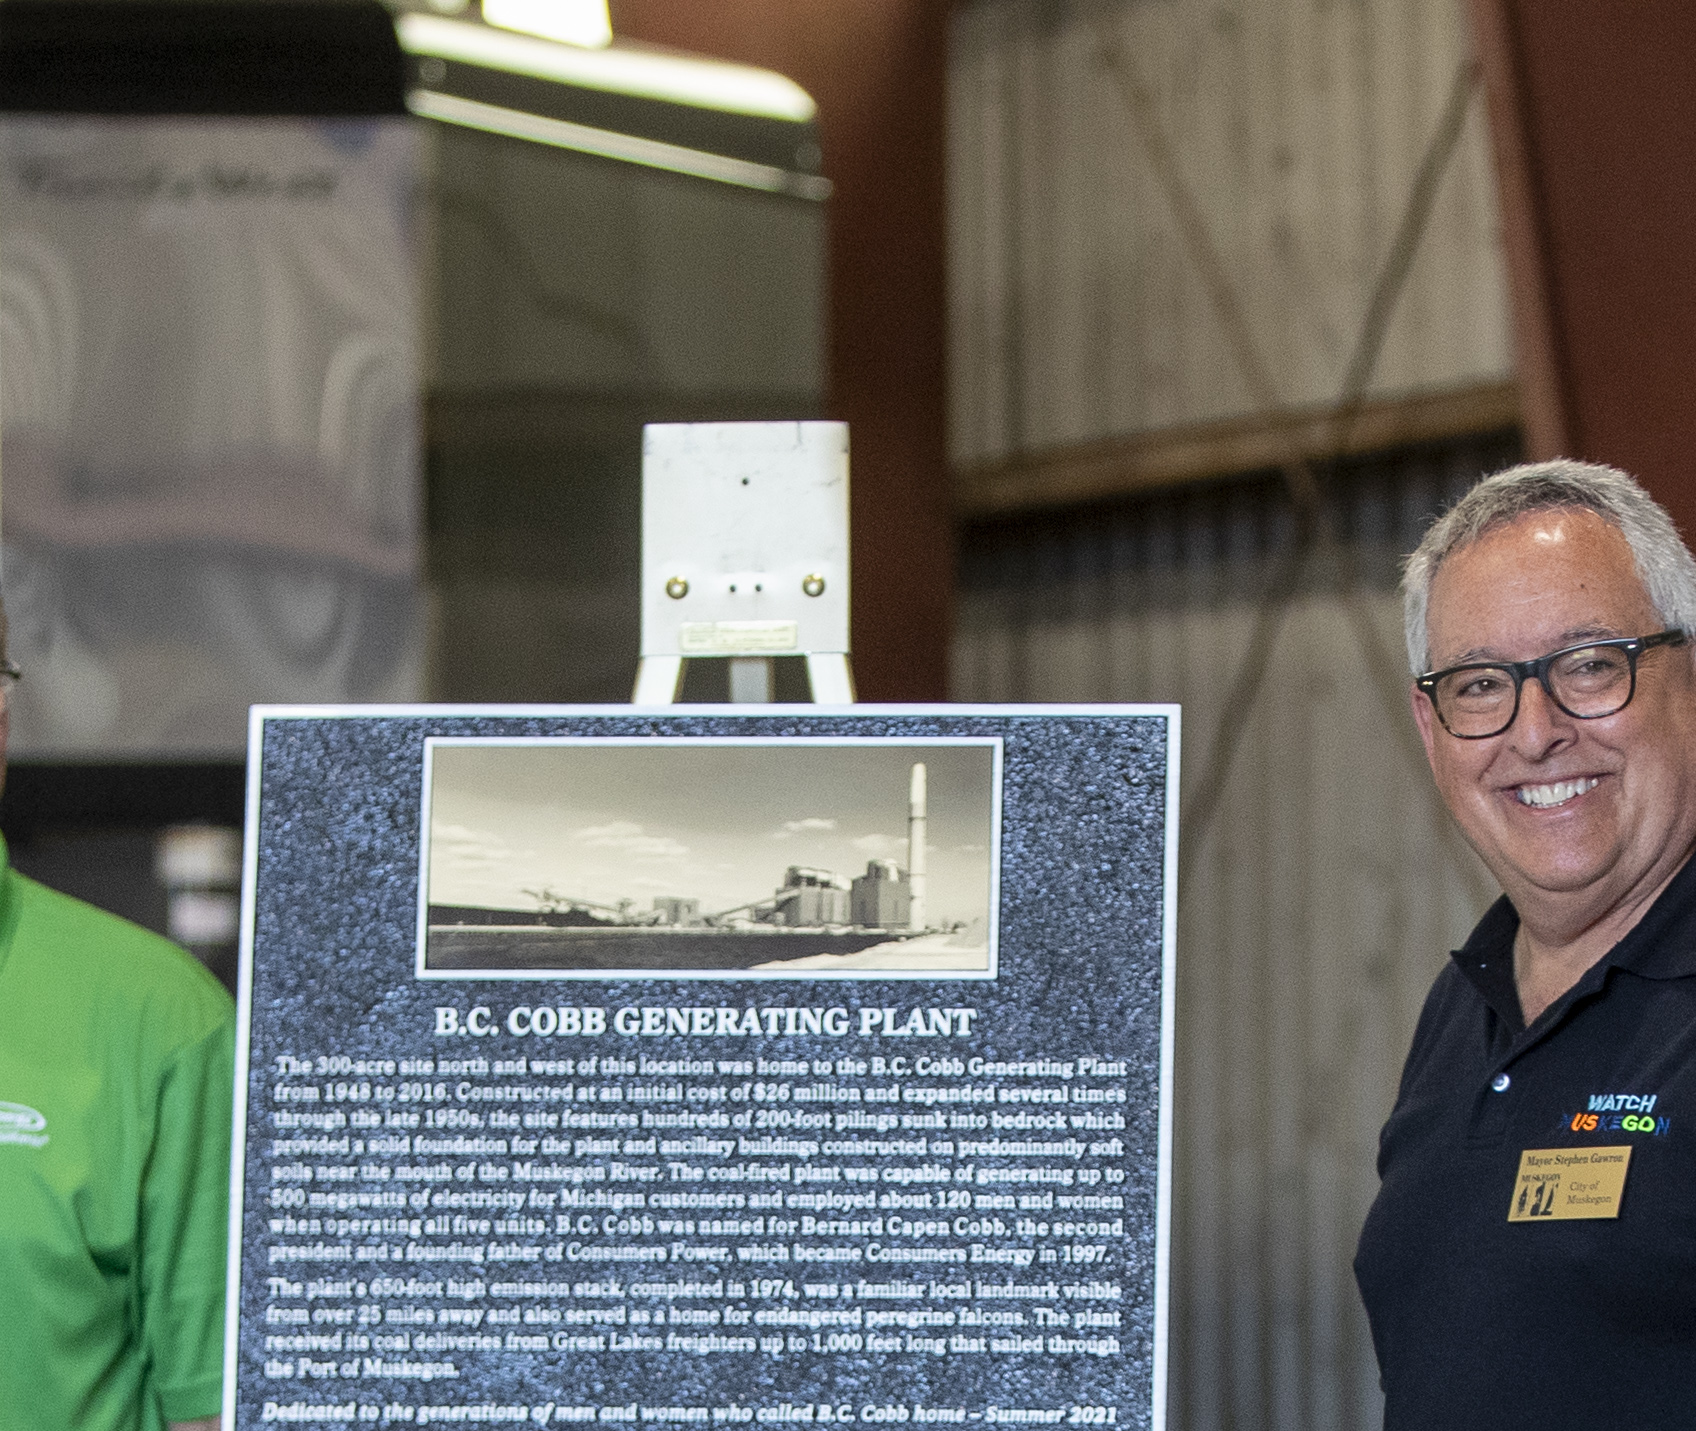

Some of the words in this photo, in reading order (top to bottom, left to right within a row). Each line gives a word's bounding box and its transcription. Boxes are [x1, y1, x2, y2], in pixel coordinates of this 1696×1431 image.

[434, 1008, 500, 1036] B.C.
[506, 1008, 606, 1036] COBB
[613, 1008, 850, 1037] GENERATING
[858, 1008, 977, 1037] PLANT
[274, 1056, 313, 1076] The
[316, 1057, 396, 1076] 300-acre
[398, 1057, 435, 1076] site
[438, 1057, 489, 1076] north
[530, 1058, 574, 1076] west
[601, 1057, 636, 1076] this
[639, 1057, 714, 1076] location
[756, 1057, 809, 1076] home
[870, 1057, 912, 1076] B.C.
[915, 1057, 965, 1076] Cobb
[968, 1057, 1074, 1079] Generating
[1077, 1057, 1127, 1076] Plant
[273, 1083, 320, 1102] from
[324, 1083, 372, 1102] 1948
[398, 1083, 452, 1102] 2016.
[456, 1084, 574, 1102] Constructed
[626, 1084, 683, 1102] initial
[686, 1086, 727, 1102] cost
[752, 1084, 790, 1102] $26
[793, 1085, 861, 1102] million
[903, 1085, 995, 1105] expanded
[998, 1085, 1069, 1103] several
[1072, 1085, 1127, 1103] times
[1587, 1093, 1658, 1113] WATCH
[273, 1110, 346, 1131] through
[384, 1110, 420, 1129] late
[424, 1110, 485, 1130] 1950s,
[522, 1110, 559, 1129] site
[561, 1110, 639, 1129] features
[642, 1111, 730, 1129] hundreds
[755, 1111, 832, 1129] 200-foot
[835, 1111, 899, 1132] pilings
[902, 1111, 947, 1130] sunk
[950, 1111, 988, 1130] into
[991, 1112, 1067, 1130] bedrock
[1070, 1112, 1126, 1130] which
[272, 1136, 349, 1158] provided
[368, 1137, 410, 1156] solid
[413, 1137, 507, 1156] foundation
[574, 1137, 620, 1158] plant
[659, 1137, 736, 1159] ancillary
[738, 1138, 819, 1159] buildings
[822, 1138, 927, 1156] constructed
[957, 1138, 1087, 1159] predominantly
[1089, 1138, 1124, 1156] soft
[1527, 1155, 1553, 1167] Mayor
[1554, 1154, 1589, 1167] Stephen
[271, 1162, 313, 1182] soils
[316, 1167, 358, 1182] near
[394, 1163, 452, 1182] mouth
[512, 1163, 605, 1184] Muskegon
[609, 1163, 666, 1182] River.
[668, 1163, 704, 1182] The
[707, 1164, 790, 1182] coal-fired
[794, 1164, 840, 1185] plant
[881, 1164, 952, 1185] capable
[976, 1164, 1074, 1185] generating
[1569, 1181, 1587, 1192] City
[1589, 1180, 1601, 1191] of
[270, 1188, 305, 1209] 500
[308, 1190, 406, 1211] megawatts
[431, 1189, 526, 1211] electricity
[560, 1190, 646, 1211] Michigan
[648, 1191, 746, 1209] customers
[786, 1190, 876, 1212] employed
[879, 1191, 933, 1209] about
[936, 1191, 971, 1209] 120
[974, 1195, 1016, 1209] men
[1056, 1196, 1124, 1209] women
[1567, 1194, 1612, 1206] Muskegon
[268, 1215, 321, 1236] when
[324, 1216, 422, 1238] operating
[424, 1216, 450, 1236] all
[453, 1216, 491, 1236] five
[494, 1216, 551, 1236] units.
[556, 1216, 599, 1236] B.C.
[602, 1216, 654, 1236] Cobb
[698, 1216, 764, 1236] named
[801, 1217, 883, 1236] Bernard
[886, 1217, 950, 1239] Capen
[954, 1217, 1011, 1238] Cobb,
[1052, 1217, 1123, 1236] second
[268, 1242, 352, 1265] president
[406, 1243, 484, 1265] founding
[487, 1243, 542, 1262] father
[566, 1243, 667, 1263] Consumers
[670, 1243, 733, 1264] Power,
[736, 1244, 789, 1263] which
[793, 1244, 862, 1263] became
[865, 1244, 967, 1263] Consumers
[970, 1244, 1036, 1266] Energy
[1062, 1244, 1112, 1263] 1997.
[267, 1278, 304, 1298] The
[306, 1278, 367, 1301] plant's
[369, 1278, 443, 1298] 650-foot
[446, 1279, 486, 1301] high
[490, 1279, 570, 1298] emission
[573, 1279, 626, 1300] stack,
[630, 1280, 723, 1301] completed
[751, 1280, 800, 1300] 1974,
[856, 1280, 926, 1299] familiar
[929, 1281, 971, 1299] local
[975, 1281, 1059, 1299] landmark
[1062, 1281, 1122, 1299] visible
[266, 1305, 310, 1325] from
[312, 1310, 355, 1325] over
[385, 1306, 435, 1325] miles
[437, 1310, 485, 1327] away
[523, 1306, 561, 1325] also
[564, 1306, 626, 1325] served
[669, 1307, 721, 1325] home
[755, 1307, 862, 1328] endangered
[865, 1307, 956, 1328] peregrine
[958, 1308, 1029, 1326] falcons.
[1032, 1308, 1070, 1326] The
[1073, 1308, 1122, 1329] plant
[265, 1333, 342, 1351] received
[345, 1333, 369, 1351] its
[372, 1333, 410, 1351] coal
[413, 1333, 502, 1351] deliveries
[505, 1333, 549, 1352] from
[554, 1334, 605, 1352] Great
[609, 1334, 664, 1352] Lakes
[666, 1334, 757, 1355] freighters
[811, 1335, 863, 1354] 1,000
[865, 1335, 903, 1352] feet
[905, 1335, 946, 1355] long
[950, 1335, 987, 1353] that
[990, 1335, 1044, 1353] sailed
[1047, 1336, 1120, 1355] through
[297, 1359, 338, 1379] Port
[362, 1359, 460, 1381] Muskegon.
[262, 1403, 356, 1422] Dedicated
[417, 1403, 529, 1425] generations
[554, 1408, 596, 1423] men
[640, 1409, 708, 1423] women
[713, 1404, 753, 1423] who
[756, 1405, 814, 1423] called
[816, 1405, 856, 1423] B.C.
[860, 1405, 909, 1423] Cobb
[912, 1405, 966, 1424] home
[984, 1405, 1066, 1424] Summer
[1068, 1406, 1117, 1424] 2021
